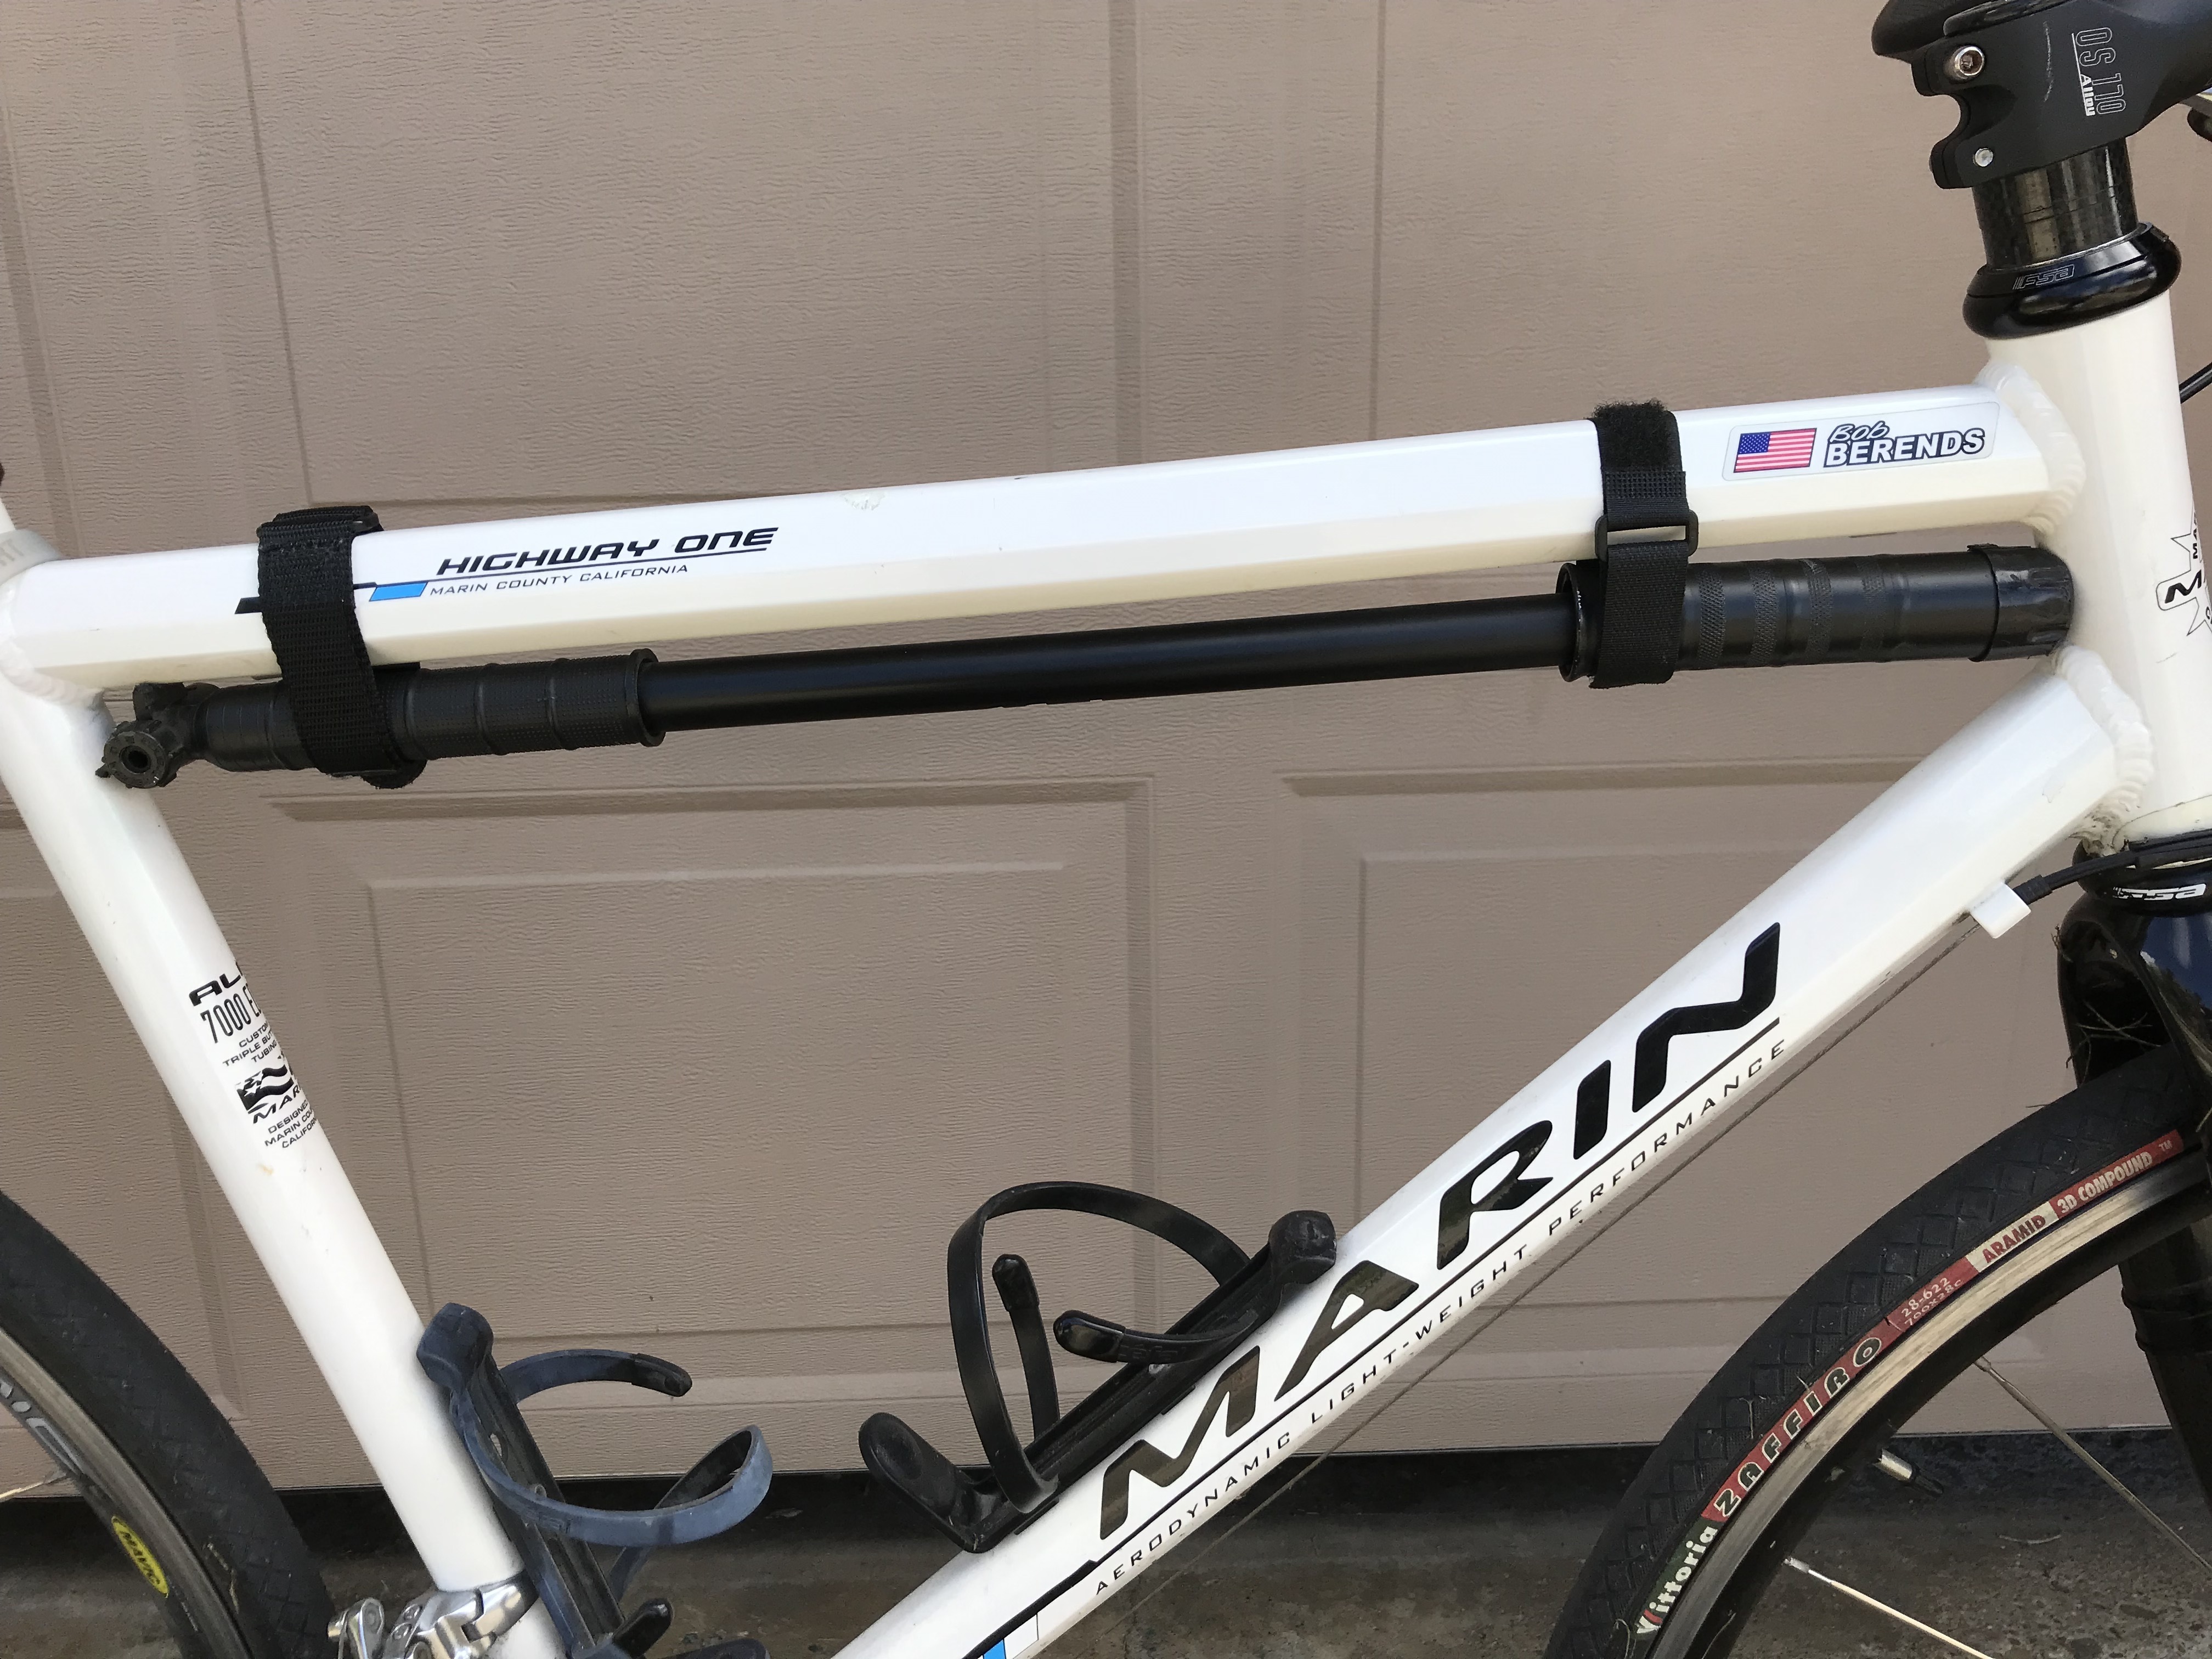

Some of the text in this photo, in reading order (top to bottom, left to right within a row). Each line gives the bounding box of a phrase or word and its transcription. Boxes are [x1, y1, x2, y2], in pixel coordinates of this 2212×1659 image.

[2076, 27, 2126, 114] OS 170
[2080, 74, 2096, 116] Alloy
[1823, 428, 1985, 468] BERENDS
[1829, 420, 1890, 443] Bob
[437, 527, 779, 575] HIGHWAY ONE
[430, 565, 689, 596] MARIN COUNTY CALIFORNIA
[222, 1028, 273, 1066] TRIPLE BUT
[253, 1085, 301, 1124] MAR
[264, 1121, 301, 1147] MARIN
[2057, 1194, 2078, 1214] 3D
[2078, 1152, 2153, 1201] COMPOUND
[1100, 922, 1781, 1541] MARIN
[1982, 1215, 2046, 1263] ARAMID
[1096, 1040, 1785, 1595] AERODYNAMIC LIGHT-WEIGHT PERFORMANCE
[1901, 1277, 1951, 1317] 28-622
[1636, 1337, 1882, 1634] Vittoria ZAFFIRO
